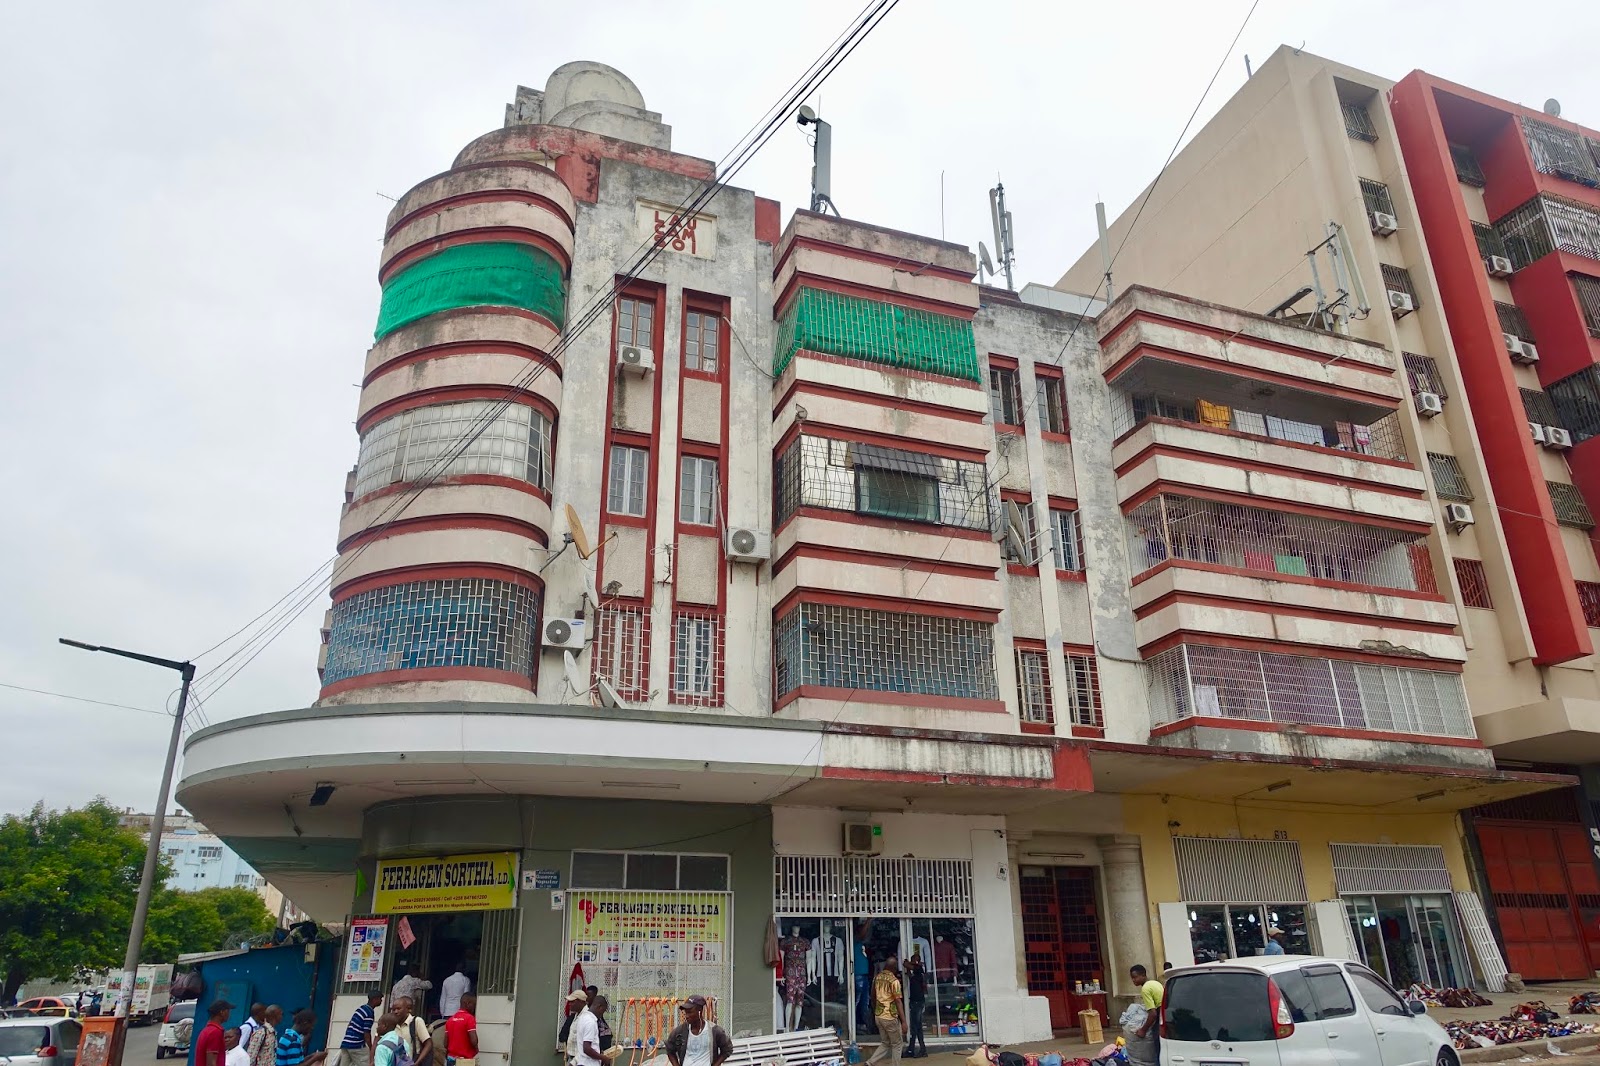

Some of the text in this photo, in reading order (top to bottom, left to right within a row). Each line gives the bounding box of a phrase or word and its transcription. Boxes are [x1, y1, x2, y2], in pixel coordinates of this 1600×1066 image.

[655, 211, 697, 231] LAU
[1274, 830, 1288, 840] 613
[381, 864, 443, 891] FERRAGEM
